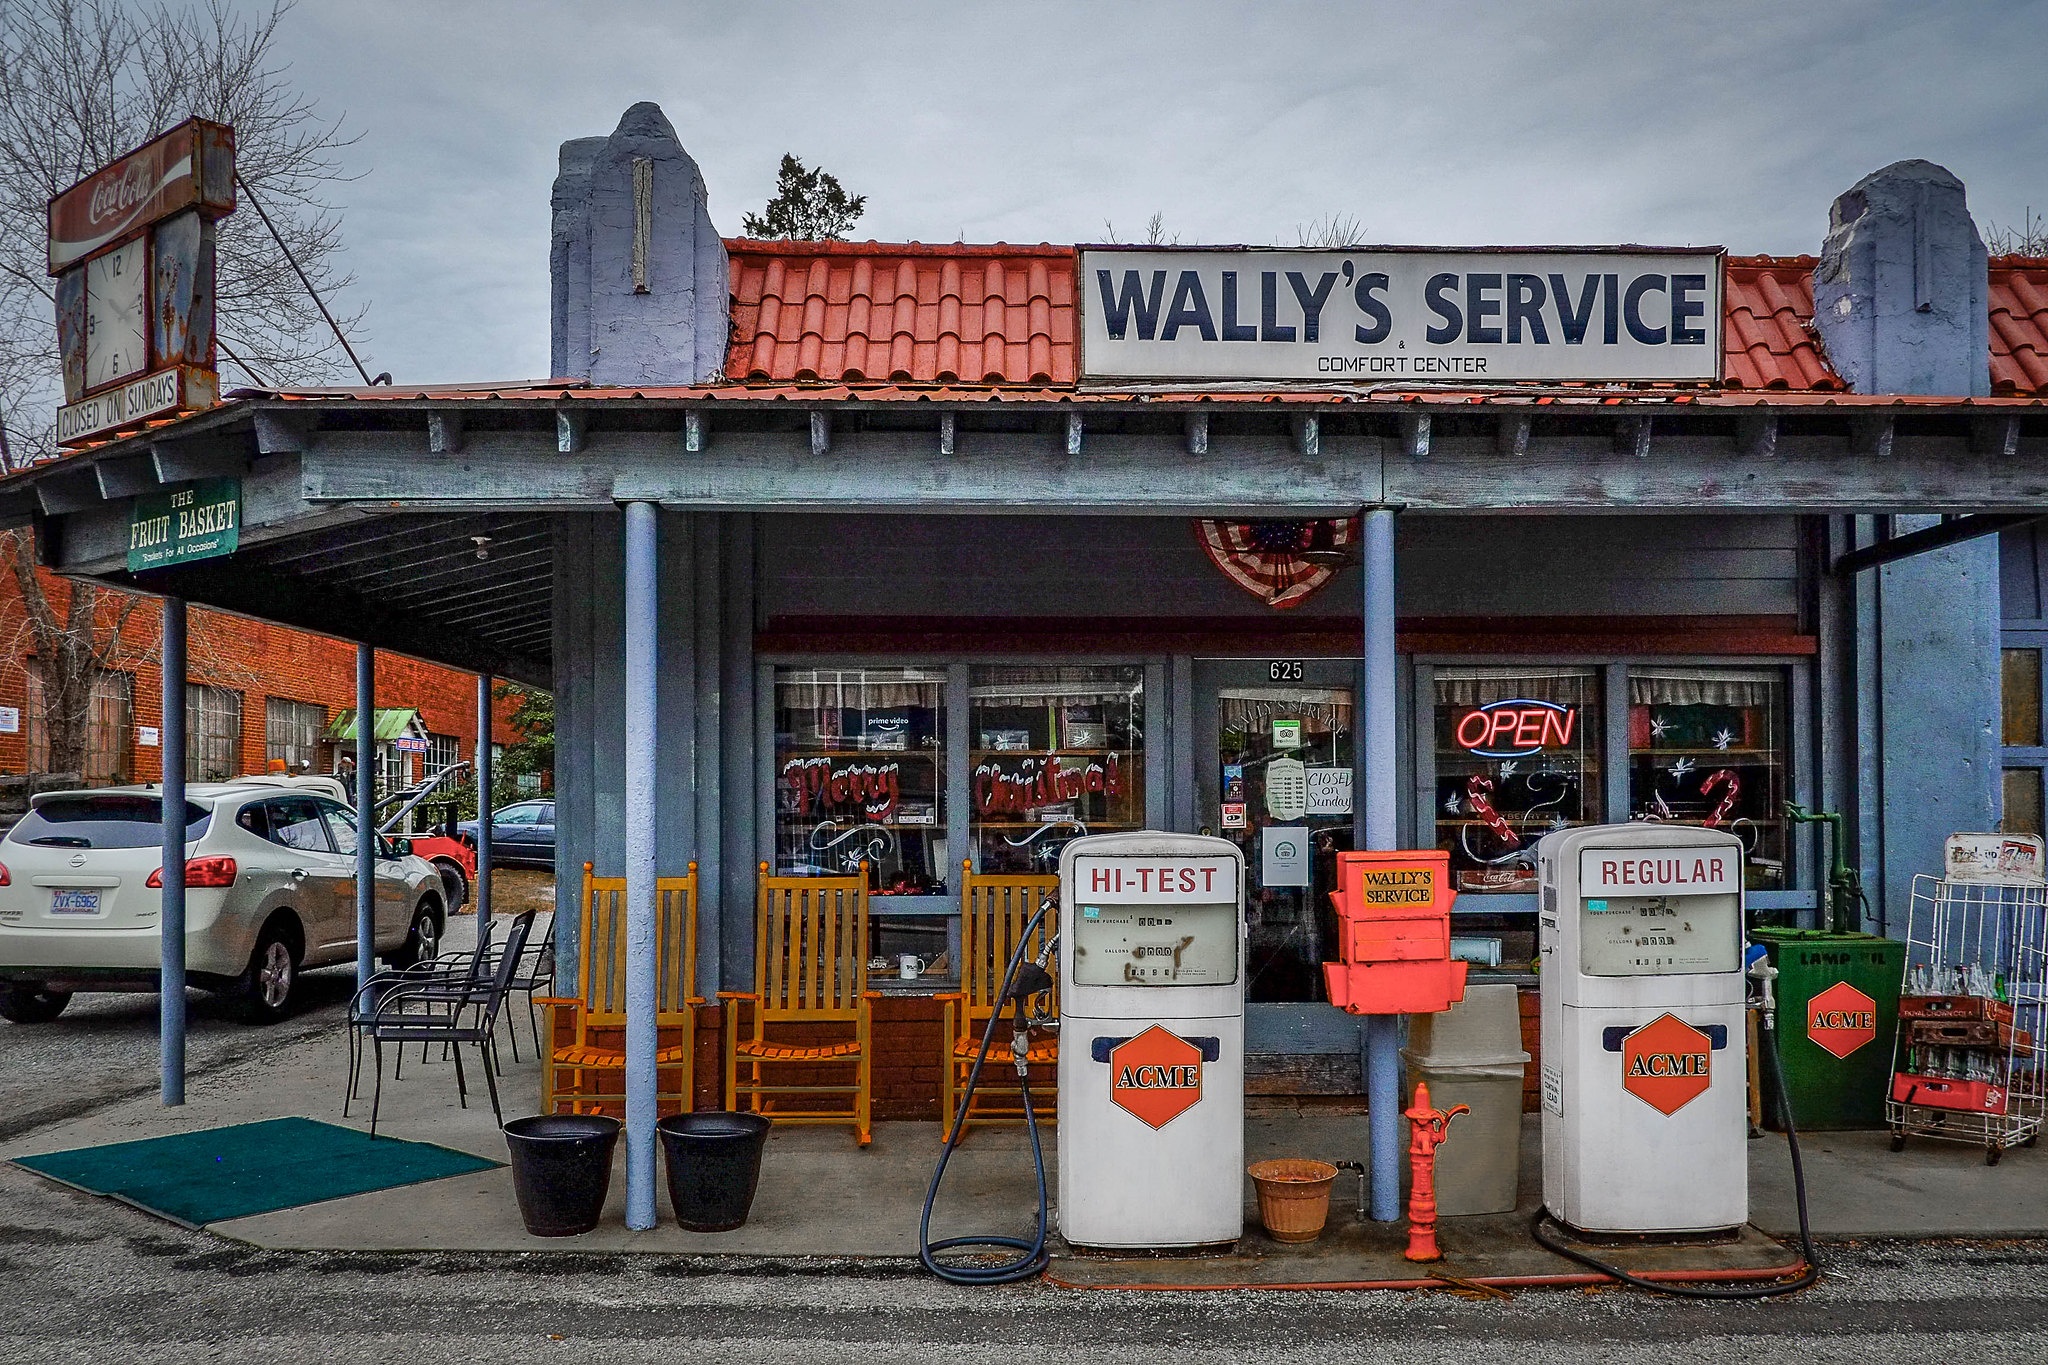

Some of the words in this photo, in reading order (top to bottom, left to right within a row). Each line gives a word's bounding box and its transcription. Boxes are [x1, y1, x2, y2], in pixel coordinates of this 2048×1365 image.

[112, 254, 121, 277] 12
[1096, 259, 1393, 344] WALLY'S
[1424, 272, 1706, 346] SERVICE
[89, 315, 95, 335] 9
[1398, 340, 1406, 350] &
[112, 354, 119, 374] 6
[1317, 356, 1408, 372] COMFORT
[1413, 357, 1488, 373] CENTER
[62, 406, 100, 438] CLOSED
[106, 393, 121, 423] ON
[128, 374, 175, 416] SUNDAYS
[171, 489, 194, 508] THE
[130, 515, 170, 550] FRUIT
[178, 500, 236, 539] BASKET
[165, 548, 175, 557] For
[176, 545, 185, 556] All
[1270, 662, 1302, 679] 625
[868, 717, 889, 725] prime
[889, 716, 909, 724] video
[1291, 702, 1348, 739] SERVICE
[1457, 708, 1575, 748] OPEN
[1321, 786, 1339, 795] on
[1307, 792, 1352, 813] Sunday
[1091, 867, 1217, 893] HI-TEST
[1365, 871, 1431, 885] WALLY'S
[1602, 858, 1724, 885] REGULAR
[53, 895, 98, 908] ZVX-6962
[1367, 889, 1430, 903] SERVICE
[1800, 952, 1851, 965] LAMP
[1811, 1011, 1873, 1029] ACME
[1628, 1053, 1708, 1077] ACME
[1116, 1065, 1199, 1089] ACME
